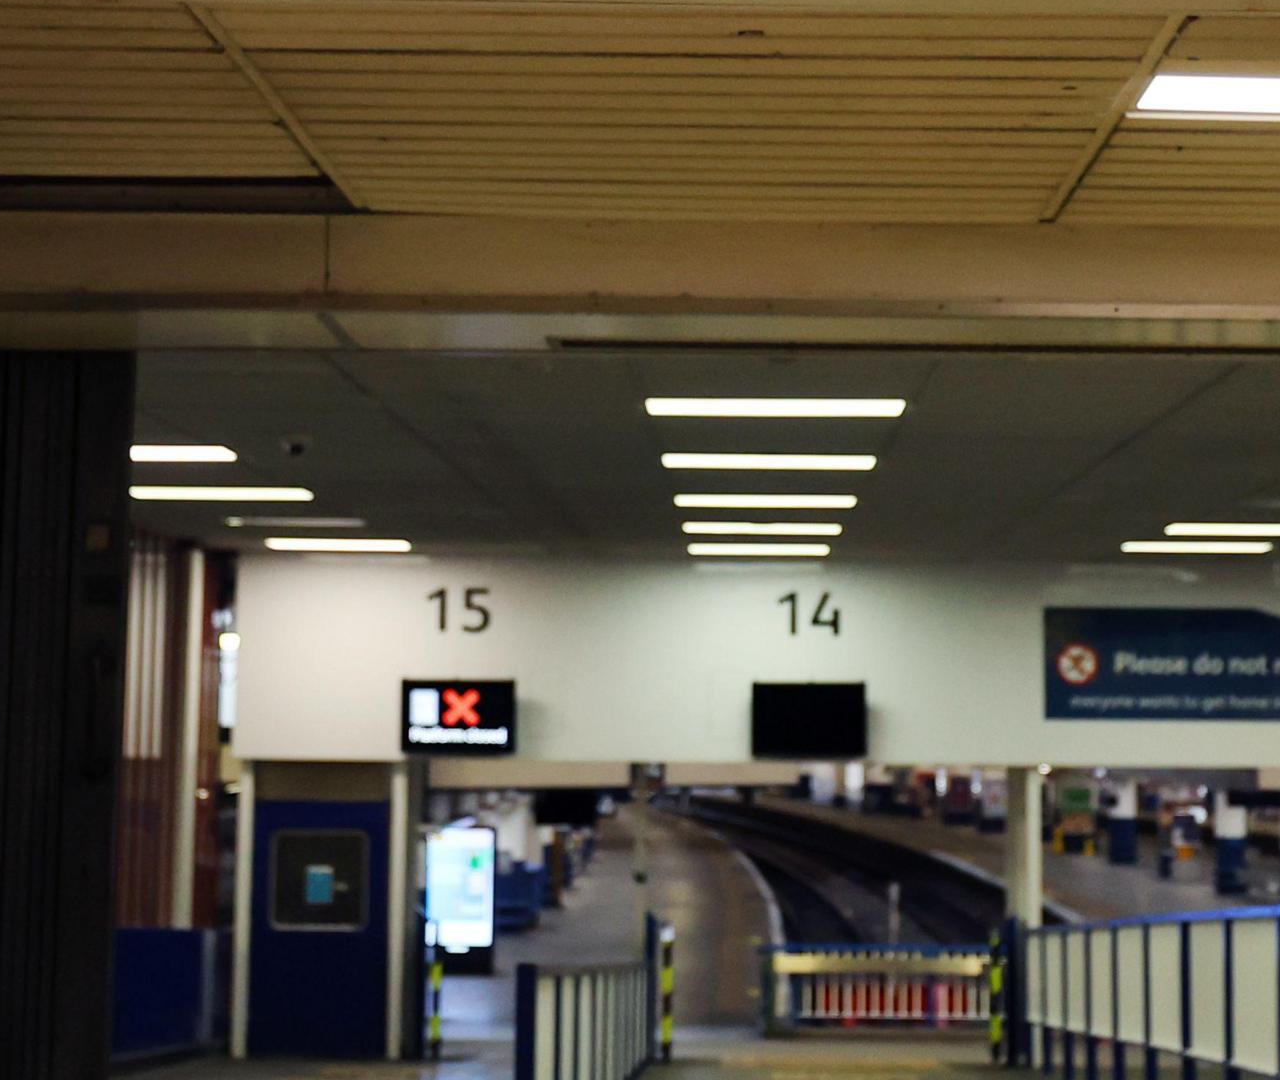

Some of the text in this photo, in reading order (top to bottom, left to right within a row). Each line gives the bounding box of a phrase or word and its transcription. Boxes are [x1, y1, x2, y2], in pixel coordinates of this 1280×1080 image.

[427, 586, 491, 634] 15
[777, 591, 842, 637] 14
[1113, 651, 1188, 676] Please
[1192, 652, 1223, 676] do
[1228, 654, 1268, 676] not
